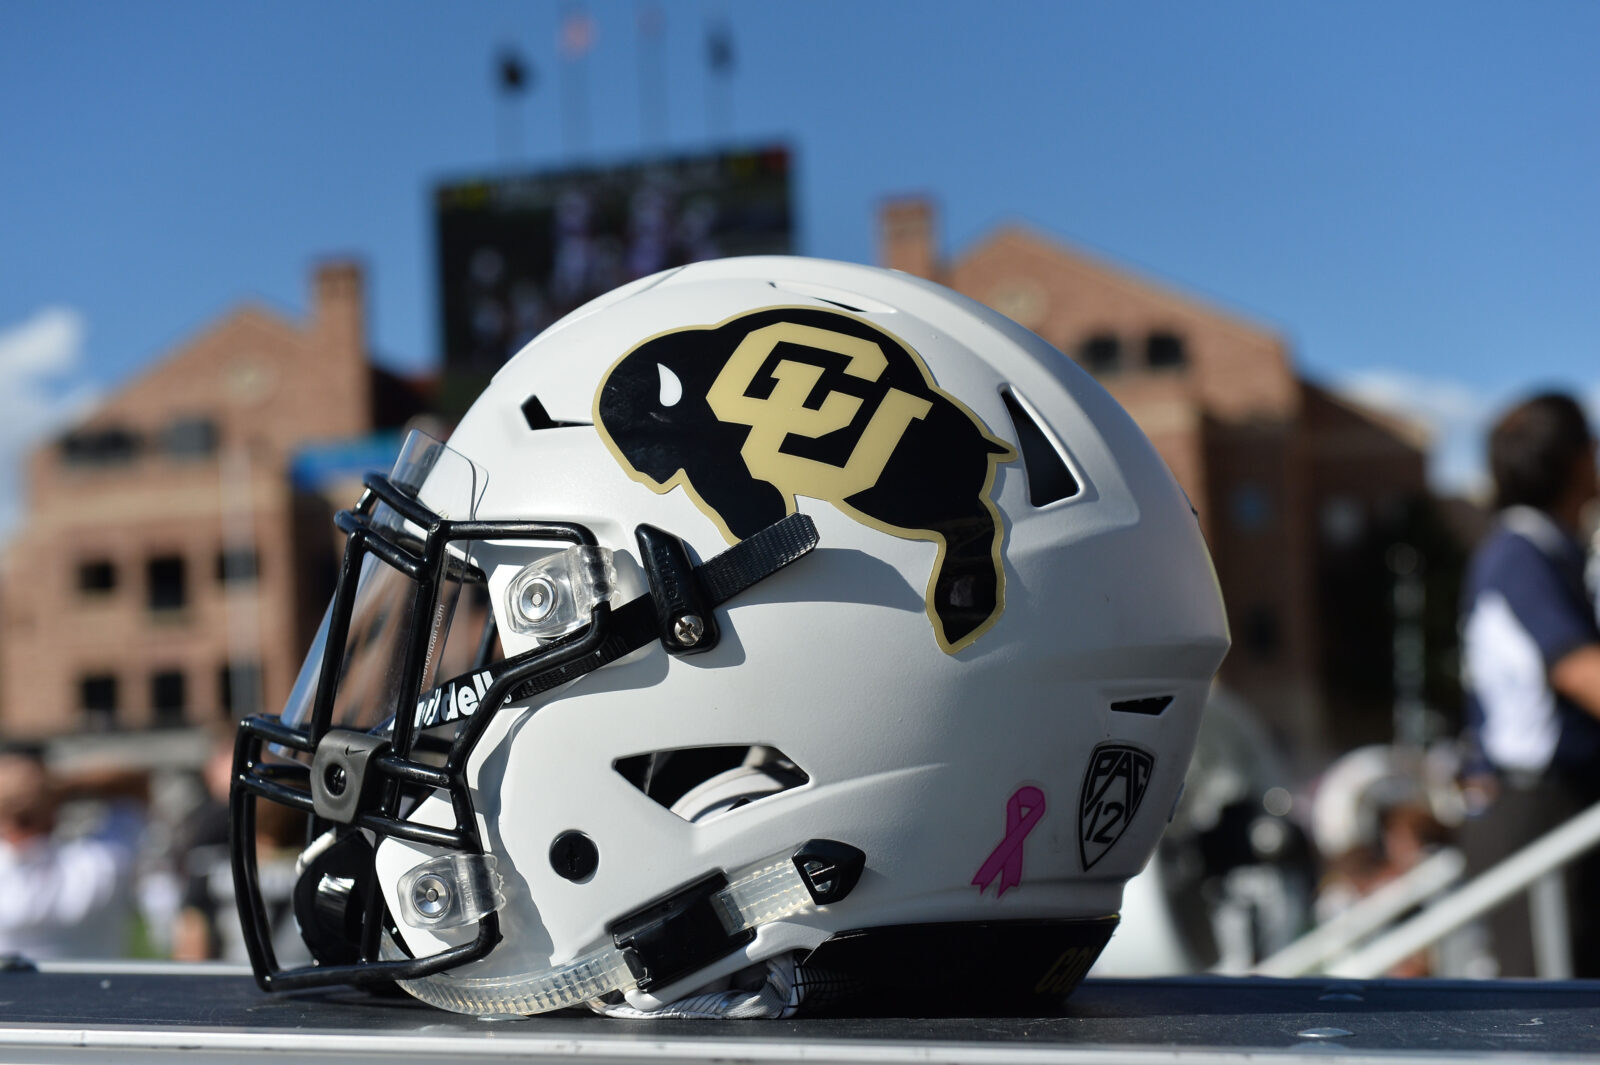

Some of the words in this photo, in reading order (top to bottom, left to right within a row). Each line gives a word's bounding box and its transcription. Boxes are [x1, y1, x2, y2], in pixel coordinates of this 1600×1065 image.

[705, 321, 934, 501] CU
[1085, 751, 1151, 824] PAC
[1085, 801, 1125, 844] 12
